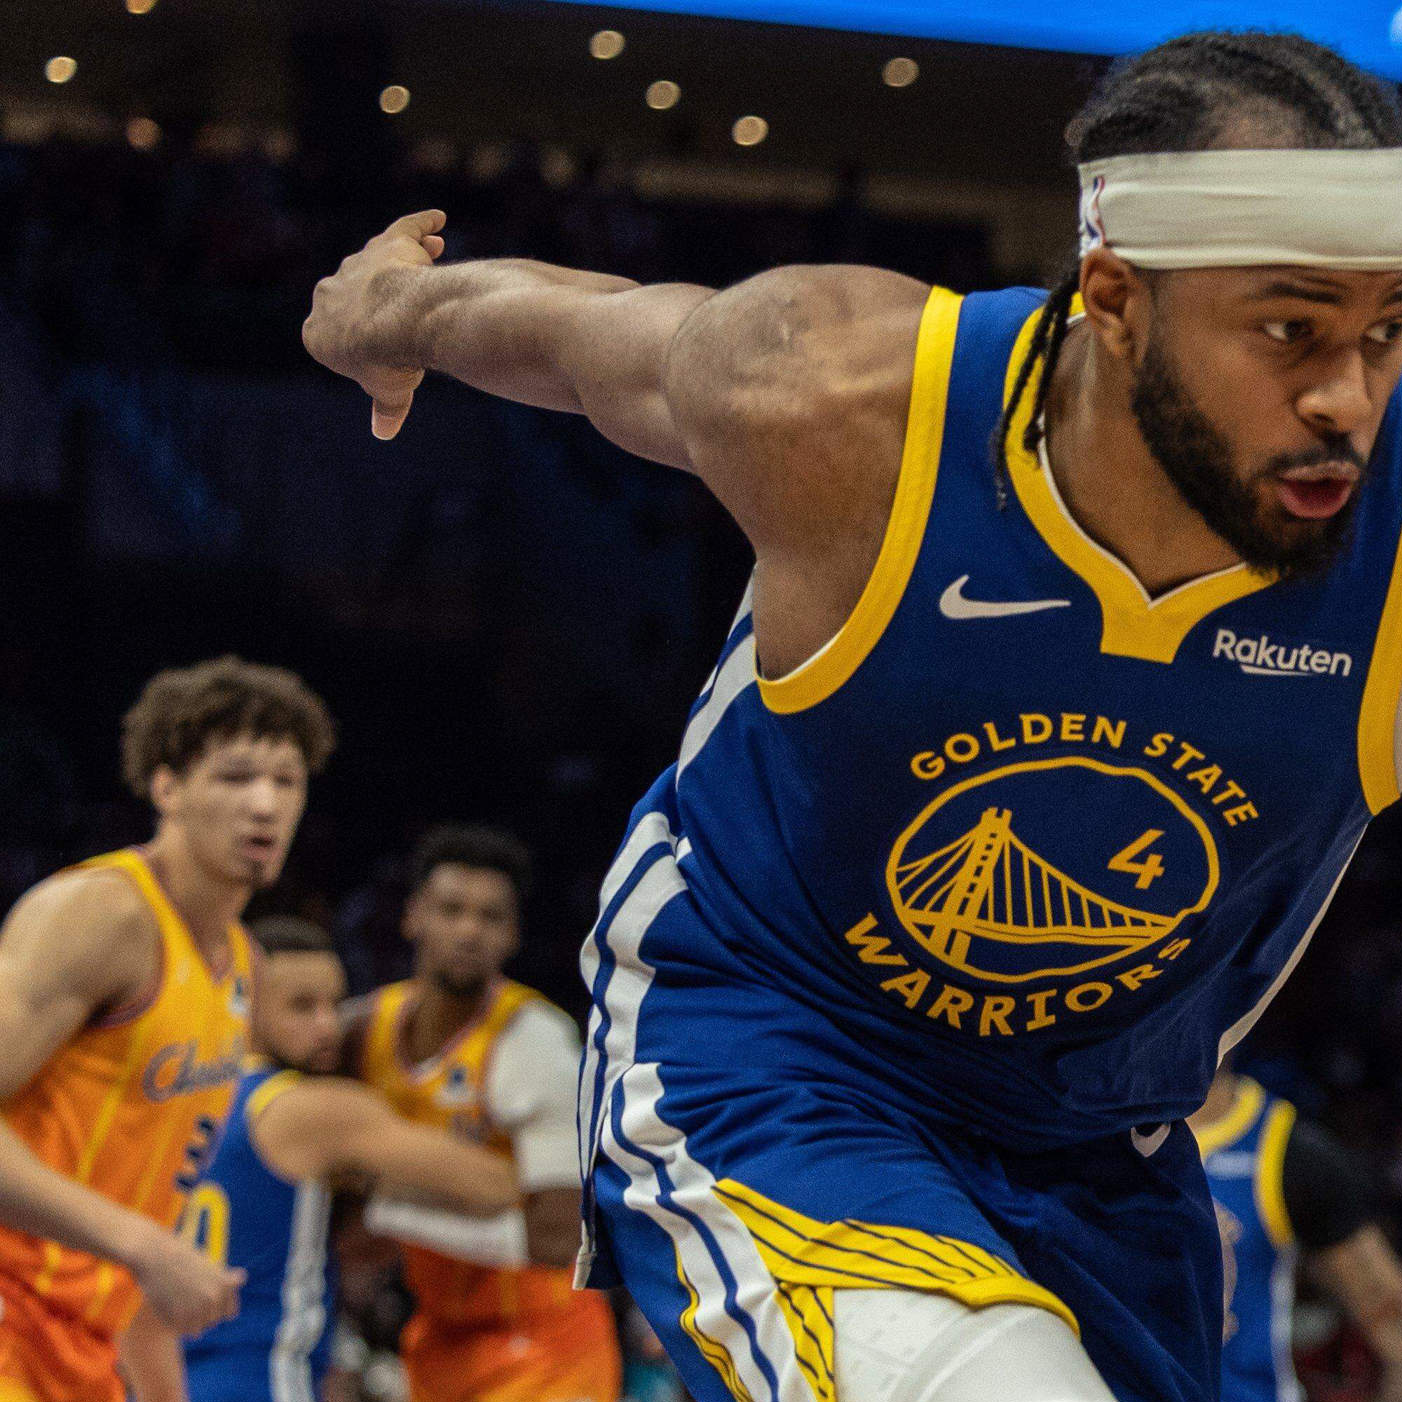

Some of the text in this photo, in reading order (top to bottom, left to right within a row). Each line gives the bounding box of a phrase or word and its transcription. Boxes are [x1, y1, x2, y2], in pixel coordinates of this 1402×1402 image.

[1212, 628, 1353, 677] Rakuten
[909, 711, 1261, 829] GOLDEN STATE
[1106, 828, 1166, 891] 4
[843, 911, 1193, 1038] WARRIORS
